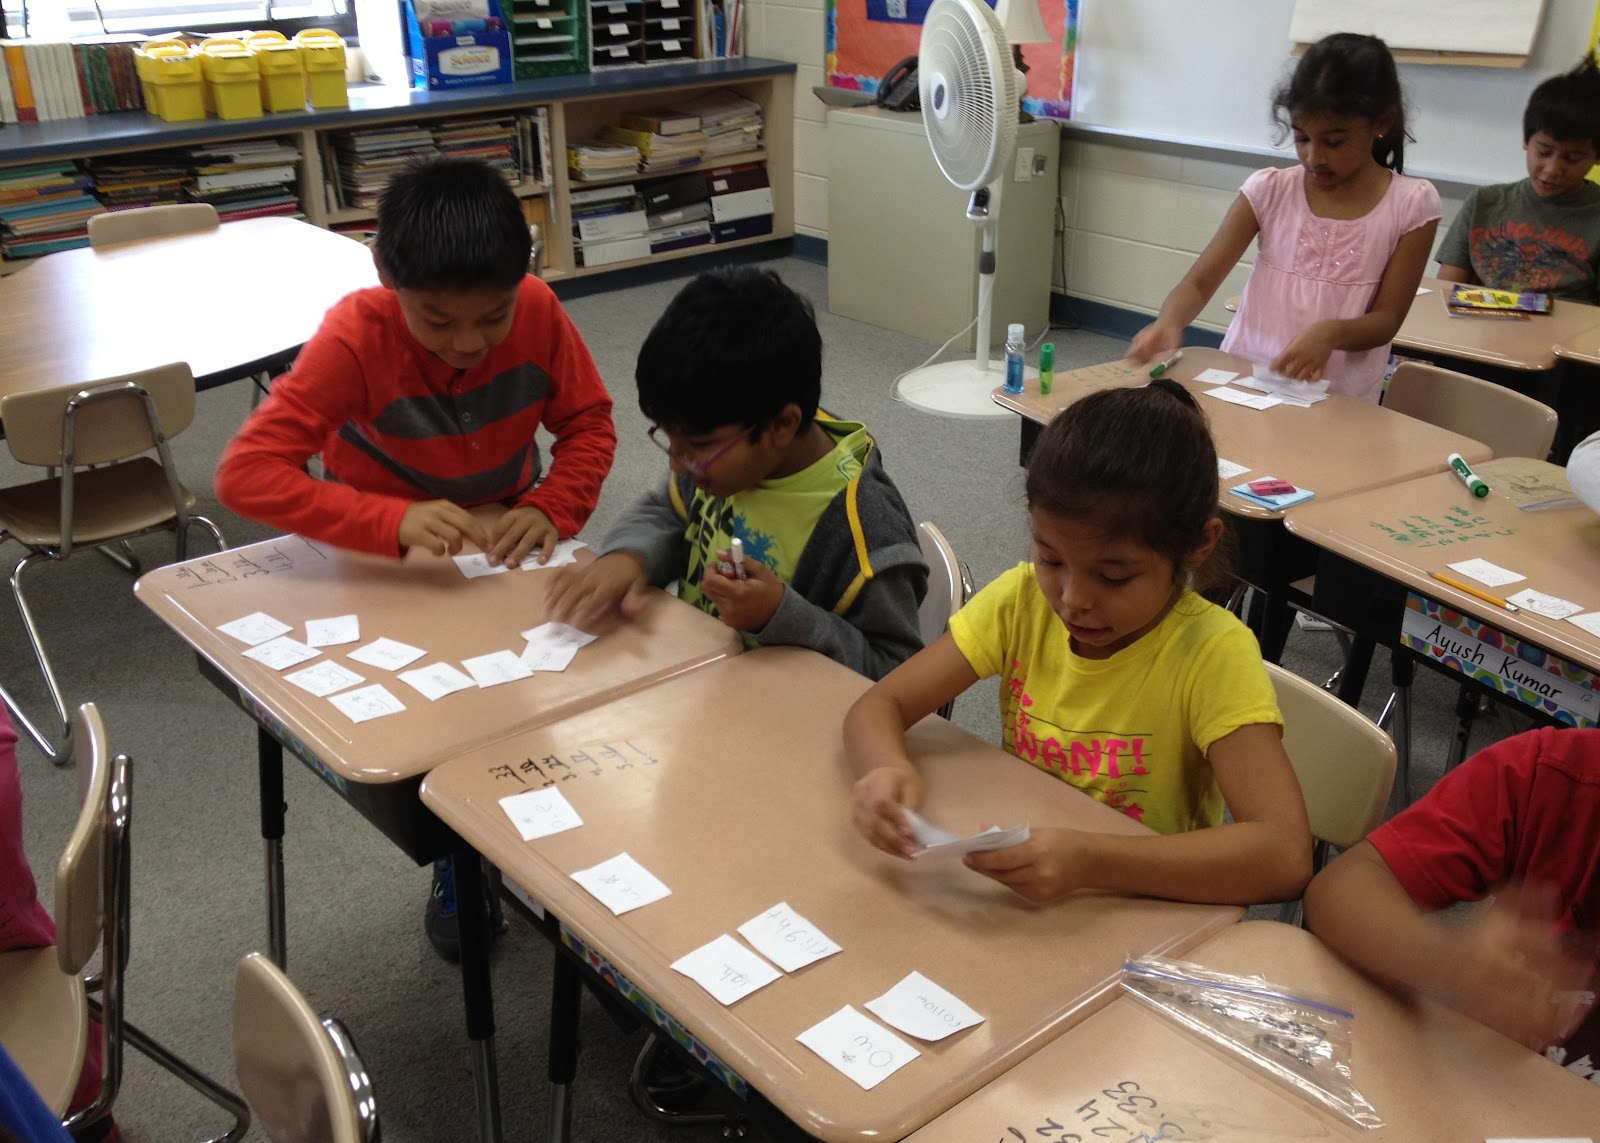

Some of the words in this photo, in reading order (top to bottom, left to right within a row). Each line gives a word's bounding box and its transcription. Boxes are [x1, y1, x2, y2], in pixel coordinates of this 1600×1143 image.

[450, 54, 491, 66] Science
[1425, 624, 1486, 665] Ayush
[1498, 655, 1563, 699] Kumar
[1013, 722, 1146, 780] WANT!
[766, 908, 830, 956] flight
